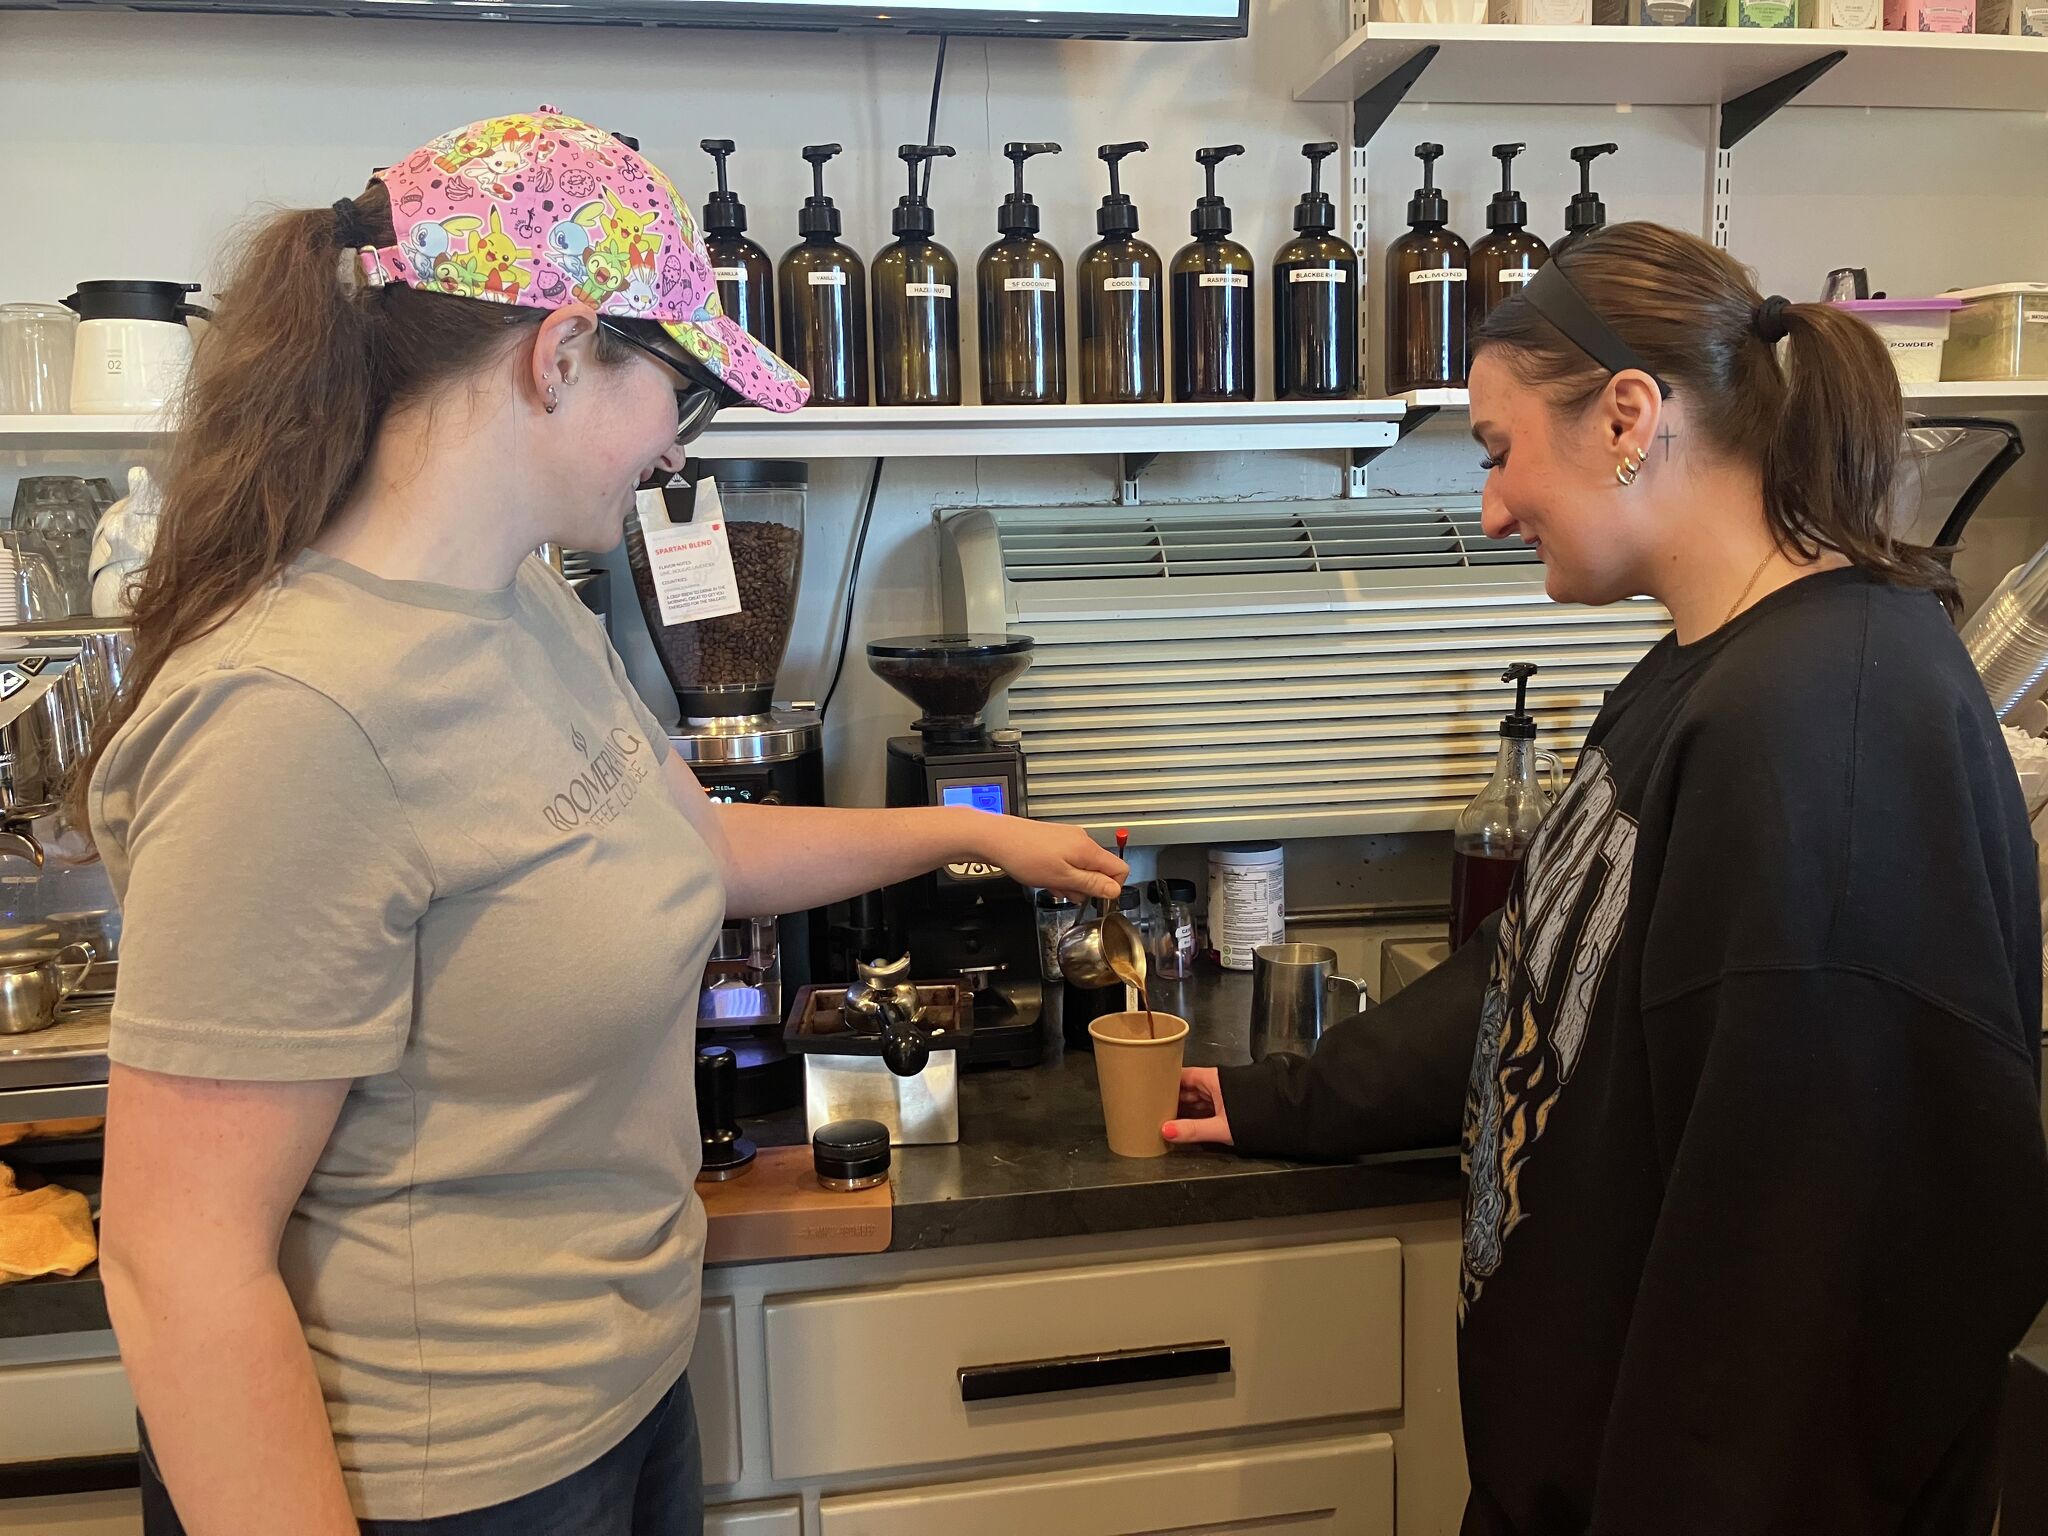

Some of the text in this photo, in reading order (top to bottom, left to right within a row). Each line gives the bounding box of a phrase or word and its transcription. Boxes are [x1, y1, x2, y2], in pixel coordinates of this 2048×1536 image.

[1416, 271, 1463, 280] ALMOND
[107, 359, 122, 370] 02
[655, 539, 712, 556] SPARTAN BLEND
